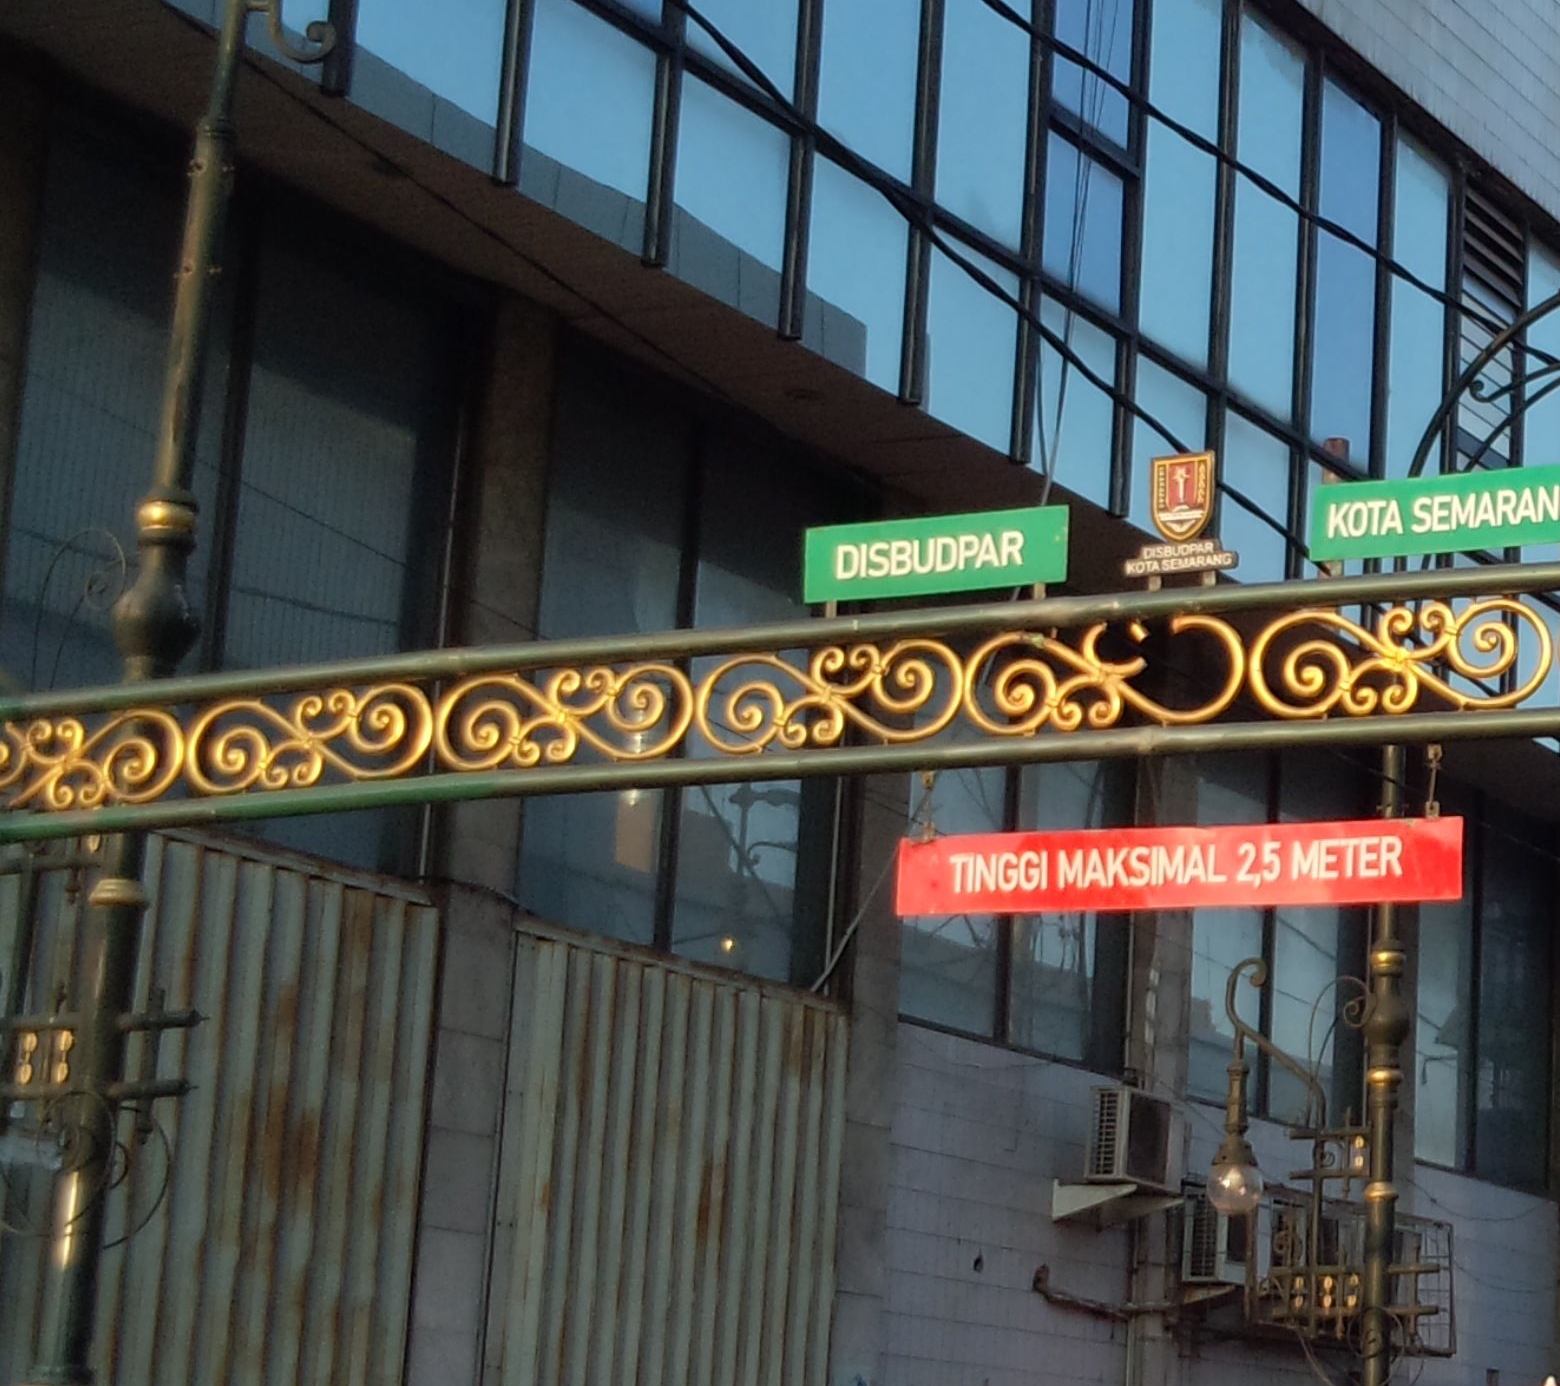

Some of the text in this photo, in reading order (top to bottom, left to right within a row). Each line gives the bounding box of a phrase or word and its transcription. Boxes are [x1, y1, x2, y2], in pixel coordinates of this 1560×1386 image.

[1327, 499, 1404, 539] KOTA
[836, 530, 1024, 580] DISBUDPAR
[1125, 552, 1233, 574] KOTA SEMARANG
[1143, 542, 1214, 559] DISBUDPAR
[950, 835, 1404, 894] TINGGI MAKSIMAL 2,5 METER
